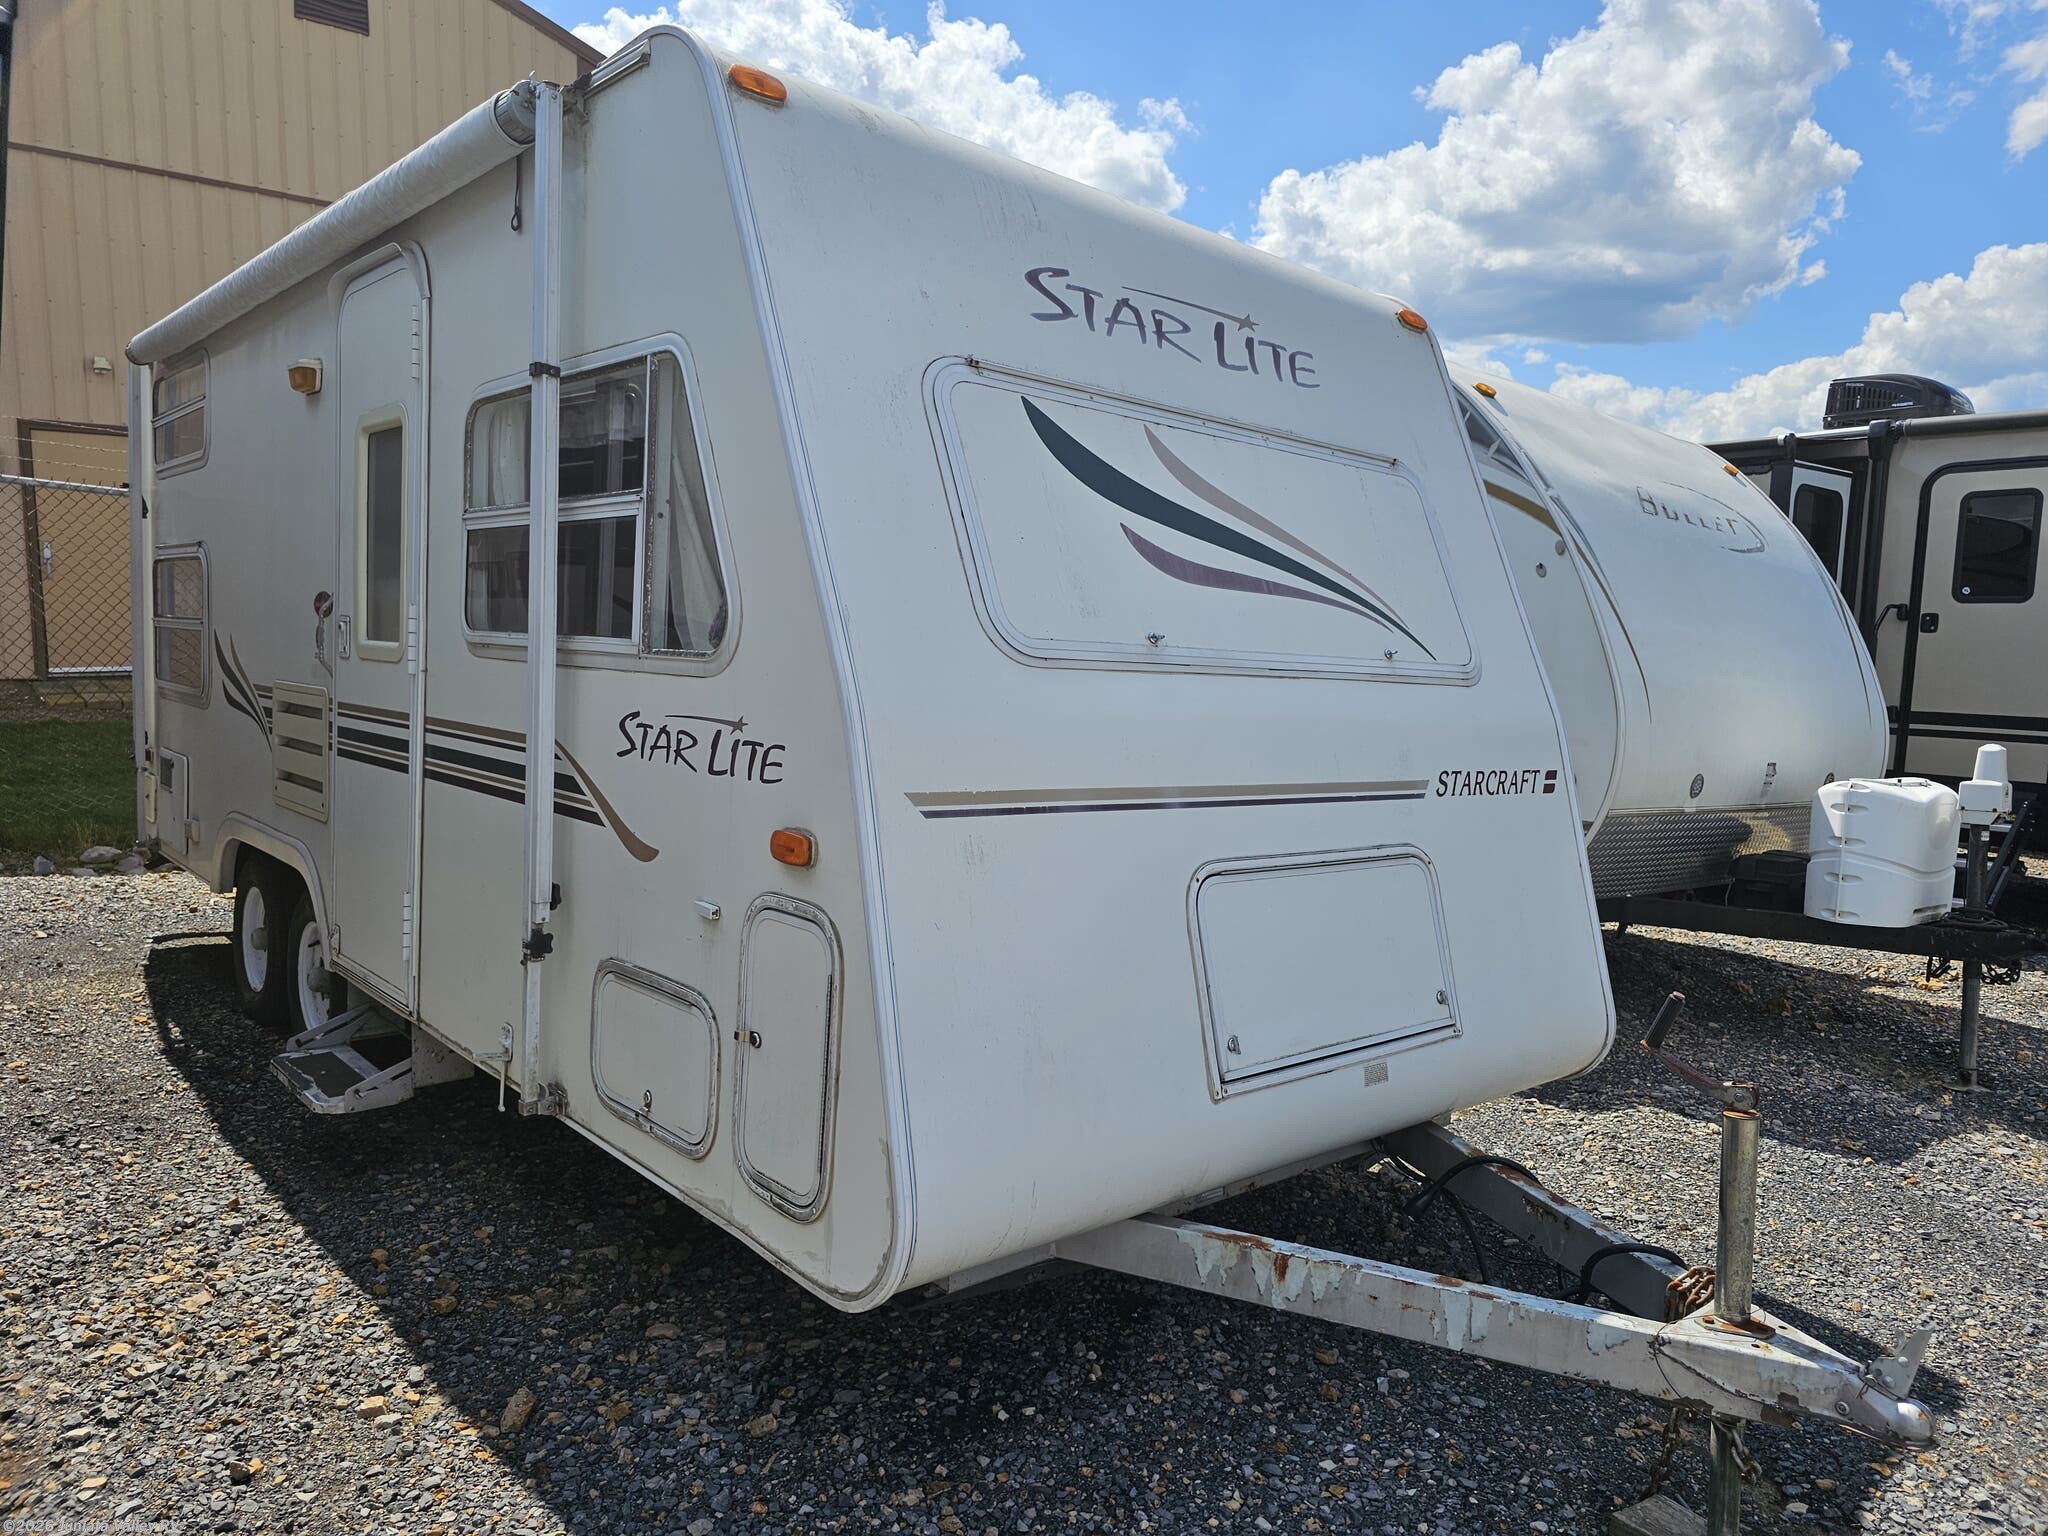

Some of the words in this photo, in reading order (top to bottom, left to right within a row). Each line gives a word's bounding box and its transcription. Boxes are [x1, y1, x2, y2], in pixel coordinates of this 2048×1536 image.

[1024, 266, 1202, 363] STAR
[1213, 321, 1320, 388] LITE
[616, 711, 698, 773] STAR
[707, 729, 786, 784] LITE
[1436, 769, 1541, 797] STARCRAFT
